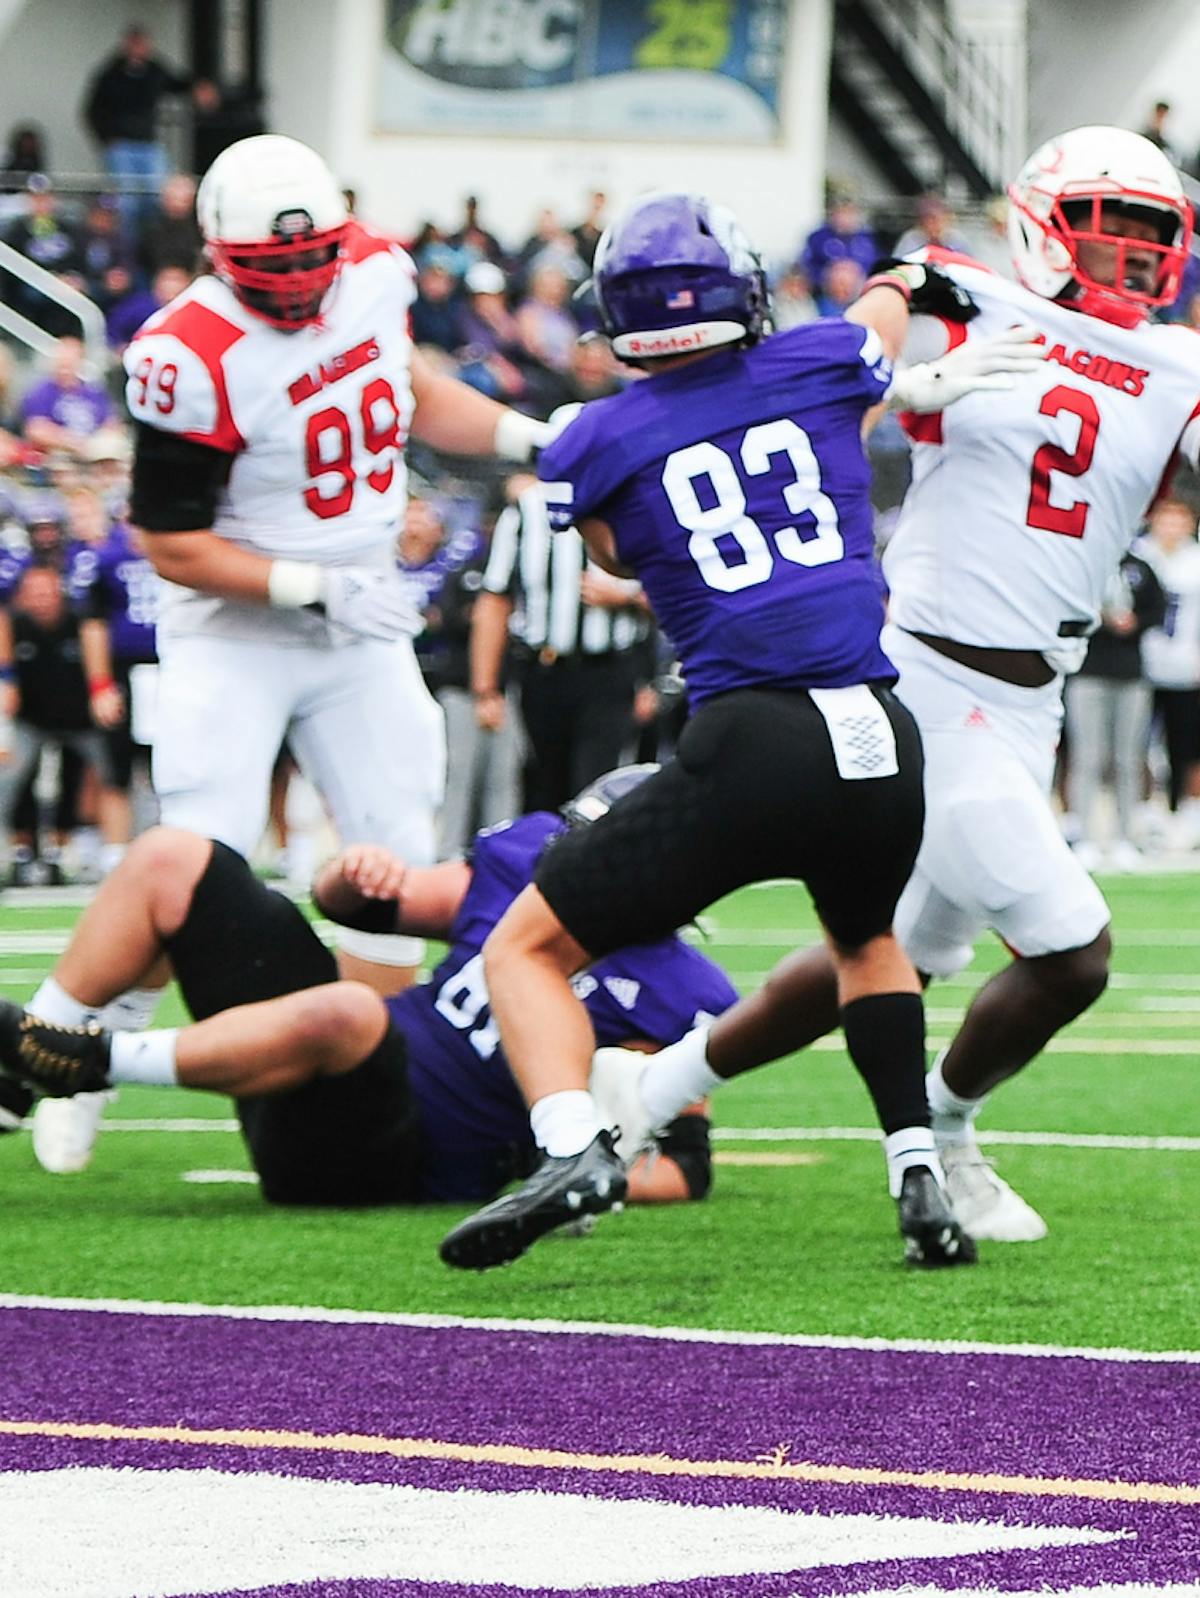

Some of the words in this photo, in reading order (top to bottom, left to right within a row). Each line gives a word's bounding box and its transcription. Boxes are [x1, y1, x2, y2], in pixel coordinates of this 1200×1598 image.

[1009, 324, 1150, 397] AGONS
[303, 377, 404, 520] 99
[661, 418, 844, 592] 83
[1026, 384, 1100, 539] 2
